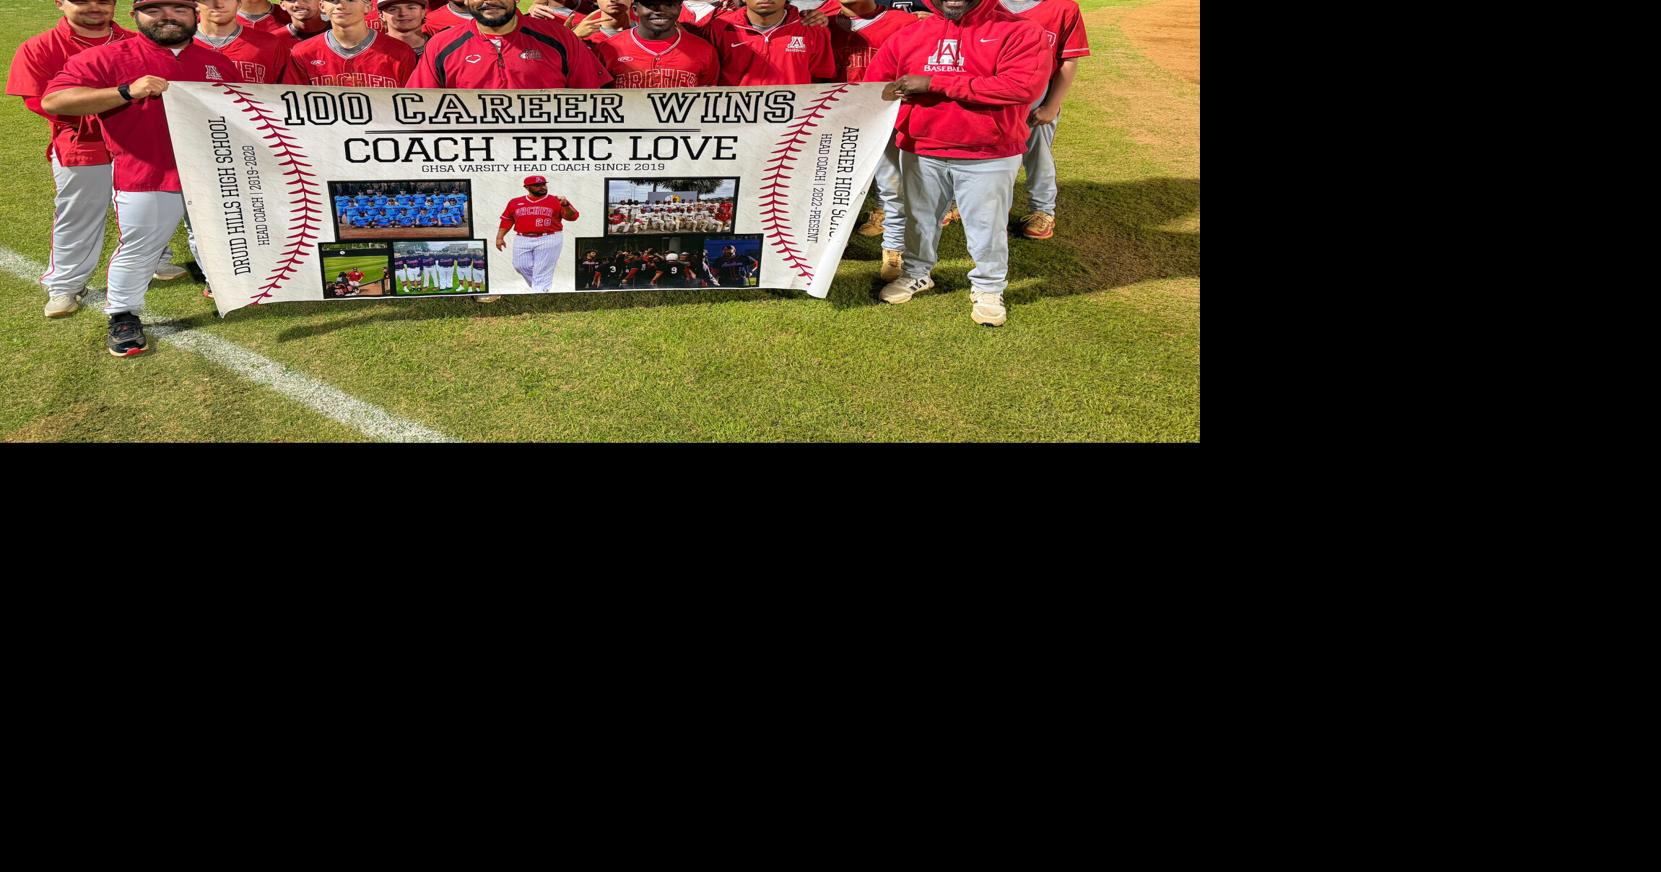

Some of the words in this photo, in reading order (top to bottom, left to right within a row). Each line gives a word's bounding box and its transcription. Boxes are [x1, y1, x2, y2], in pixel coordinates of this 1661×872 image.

[928, 39, 965, 66] A
[280, 91, 373, 126] 100
[392, 93, 624, 124] CAREER
[647, 90, 796, 124] WINS
[208, 116, 234, 164] SCHOOL
[344, 137, 494, 163] COACH
[512, 136, 613, 162] ERIC
[629, 136, 738, 160] LOVE
[818, 133, 832, 154] HEAD
[837, 126, 860, 174] ARCHER
[242, 146, 262, 190] 2019-2020
[422, 164, 456, 173] GHSA
[458, 164, 510, 172] VARSITY
[514, 164, 547, 172] HEAD
[550, 164, 590, 172] COACH
[594, 163, 630, 171] SINCE
[634, 163, 665, 171] 2019
[815, 156, 828, 182] COACH
[218, 168, 240, 198] HIGH
[832, 177, 852, 206] HIGH
[224, 200, 246, 235] HILLS
[252, 197, 267, 223] COACH
[807, 188, 824, 244] 2022-PRESENT
[256, 224, 270, 246] HEAD
[230, 237, 252, 276] DRUID
